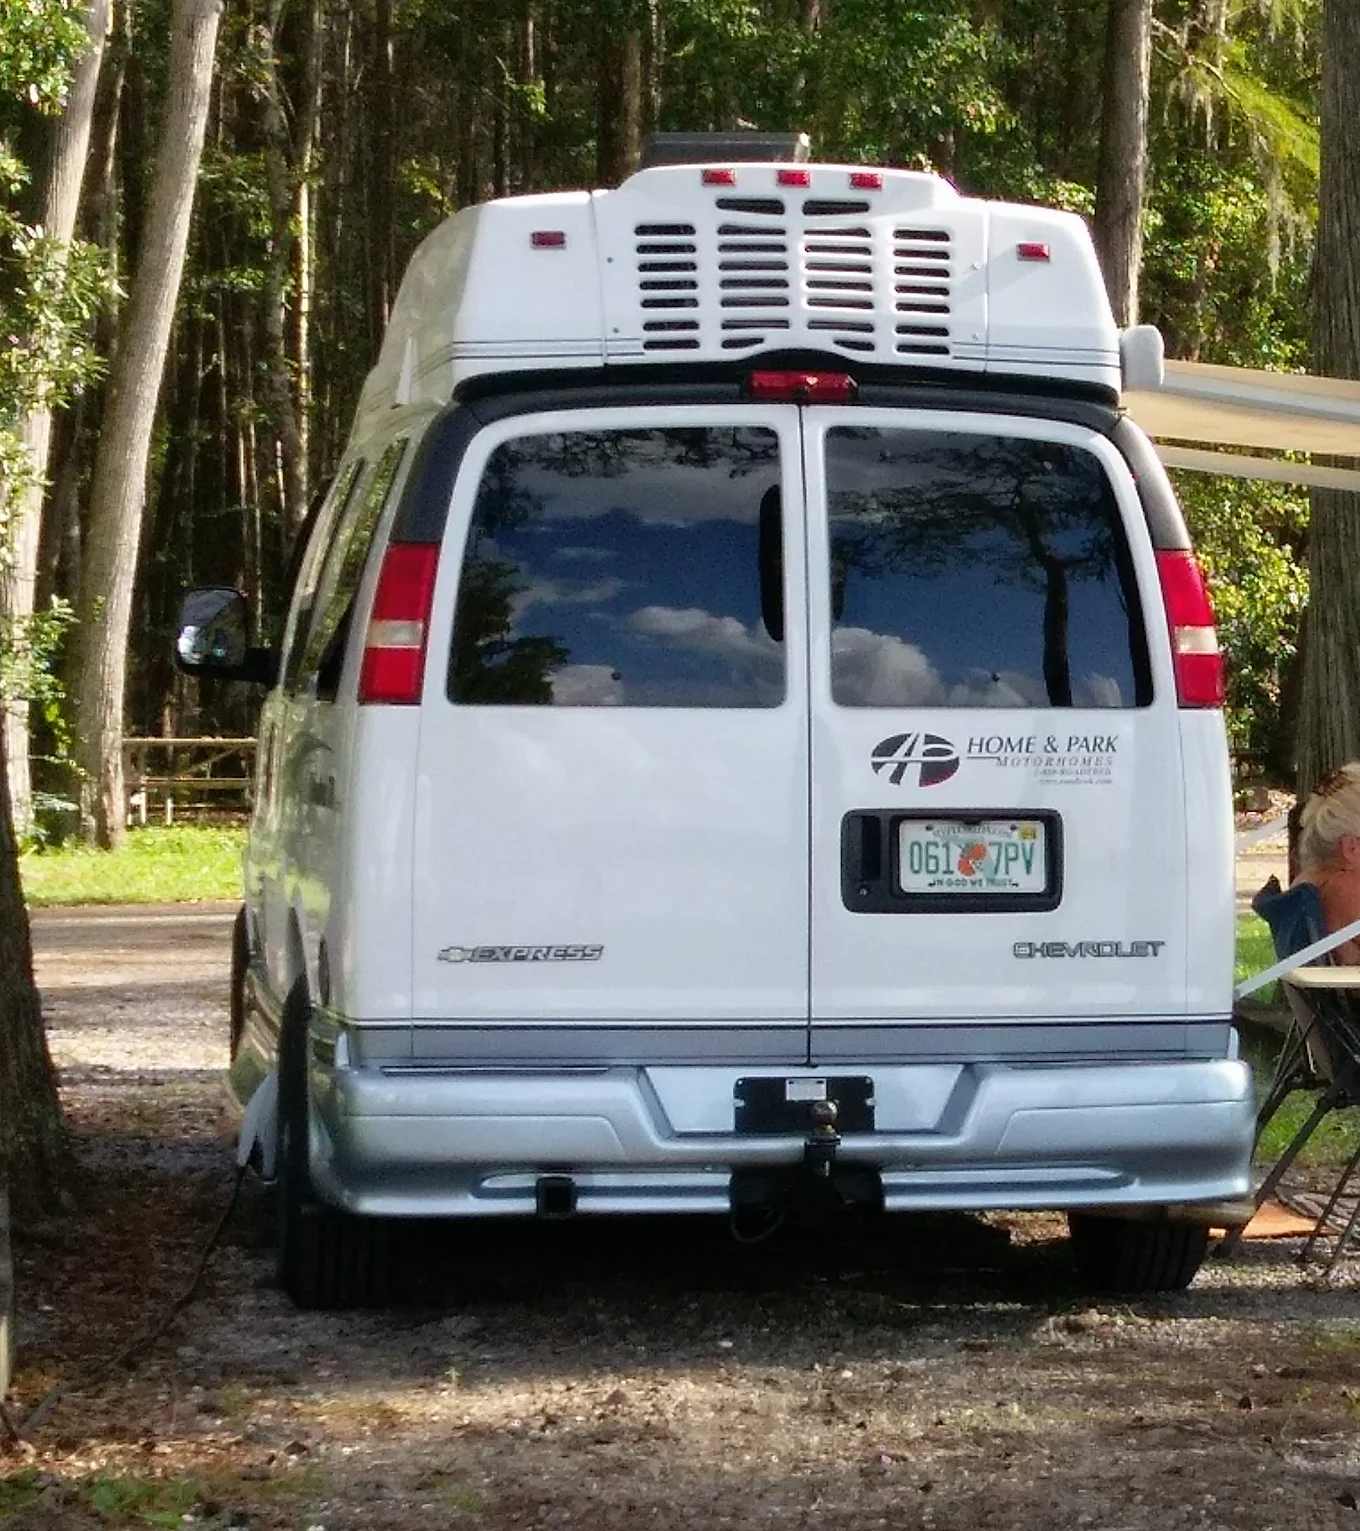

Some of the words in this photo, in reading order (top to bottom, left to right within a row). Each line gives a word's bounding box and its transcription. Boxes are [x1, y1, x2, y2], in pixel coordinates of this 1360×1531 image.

[967, 736, 1037, 754] HOME
[1044, 735, 1059, 754] &
[1067, 735, 1119, 753] PARK
[996, 756, 1113, 767] MOTORHOMES
[910, 841, 955, 875] 061
[988, 842, 1035, 876] 7PV
[468, 944, 604, 963] EXPRESS
[1013, 940, 1166, 959] CHEVROLET
